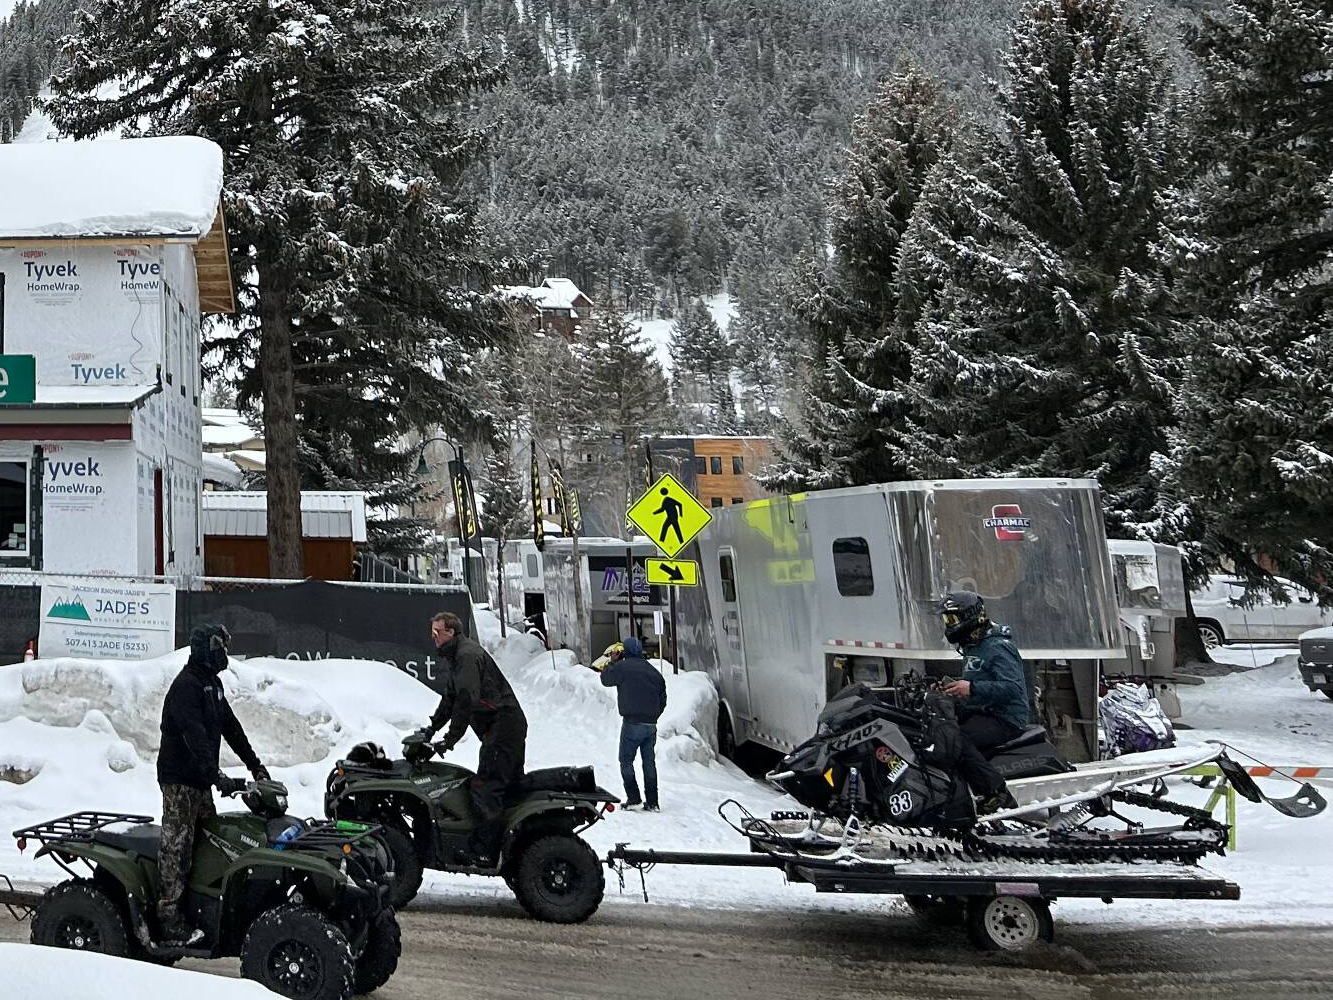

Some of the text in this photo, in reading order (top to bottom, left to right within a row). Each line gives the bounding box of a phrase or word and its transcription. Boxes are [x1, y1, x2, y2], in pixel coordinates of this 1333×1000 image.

[24, 260, 77, 282] Tyvek
[116, 260, 160, 280] Tyve
[121, 281, 159, 290] HomeW
[71, 363, 125, 384] Tyvek
[984, 518, 1030, 528] CHARMAC
[95, 599, 149, 615] JADE'S
[889, 790, 913, 815] 33
